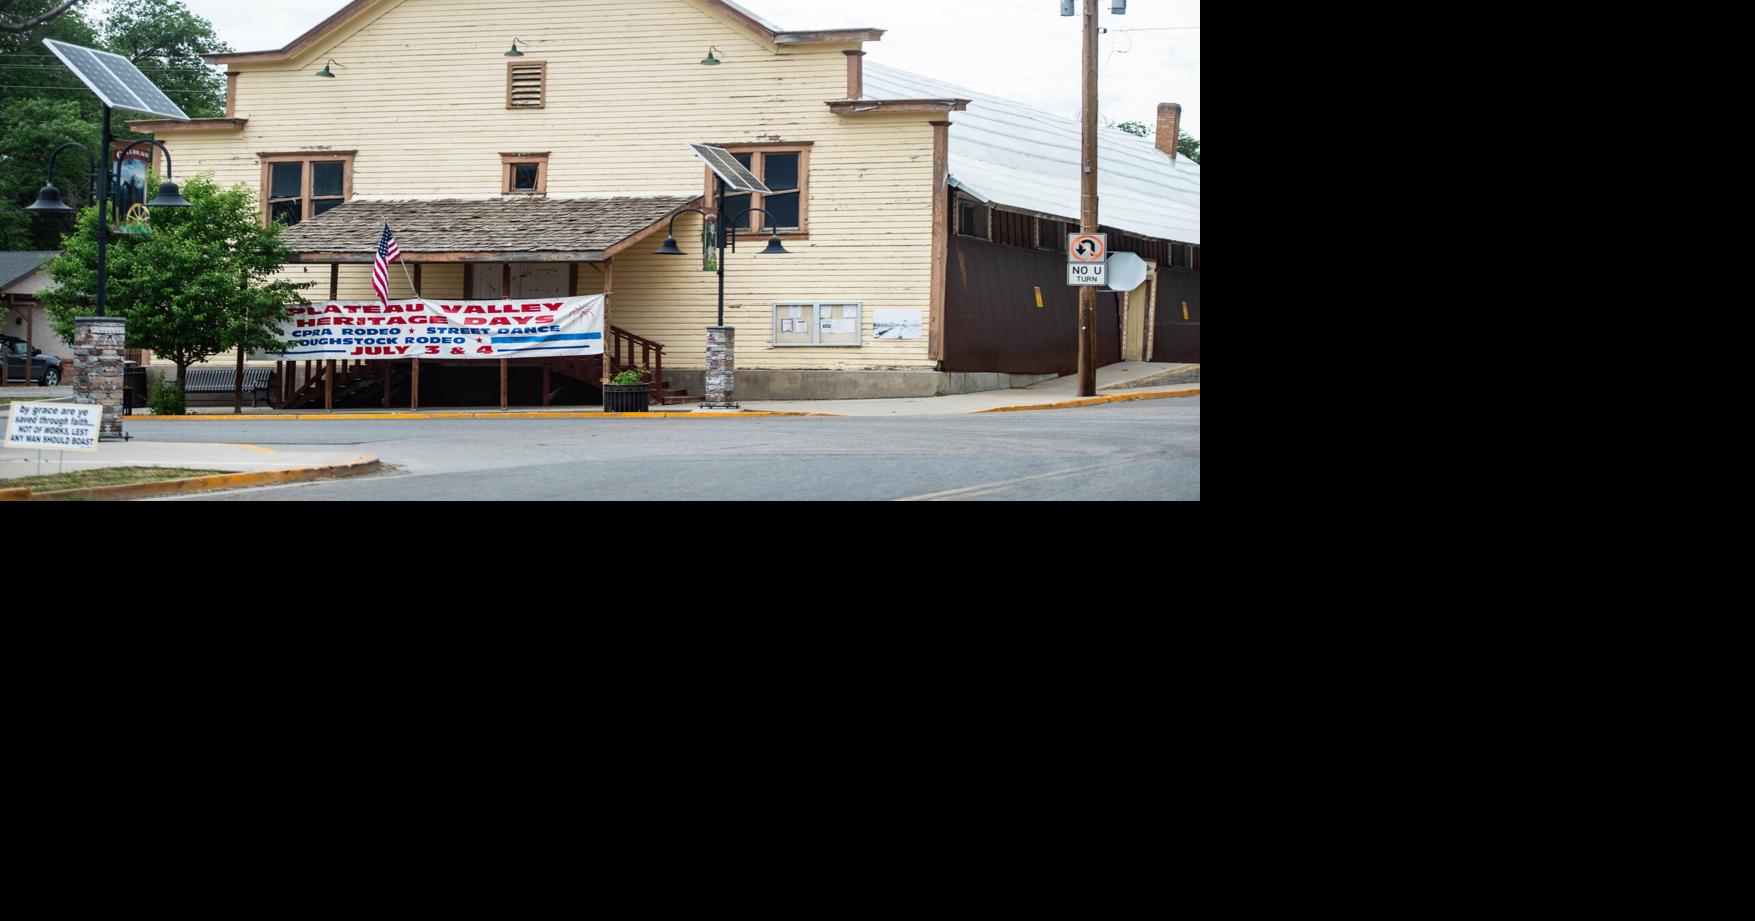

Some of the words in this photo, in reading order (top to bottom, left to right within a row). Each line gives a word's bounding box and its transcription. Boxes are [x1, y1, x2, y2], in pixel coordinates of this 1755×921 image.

[1072, 266, 1088, 275] NO
[1094, 266, 1101, 275] U
[286, 303, 424, 316] PLATEAU
[440, 302, 563, 313] VALLEY
[296, 315, 448, 328] HERITAGE
[464, 315, 554, 326] DAYS
[291, 328, 333, 337] CPRA
[341, 327, 402, 336] RODEO
[426, 326, 491, 335] STREET
[497, 325, 560, 334] DANCE
[405, 336, 466, 344] RODEO
[351, 345, 409, 356] JULY
[425, 345, 440, 355] 3
[450, 347, 465, 355] &
[476, 345, 494, 354] 4
[19, 404, 29, 415] by
[32, 407, 59, 415] grace
[78, 409, 89, 418] ye
[15, 416, 37, 424] saved
[39, 416, 69, 427] through
[10, 434, 24, 442] ANY
[26, 435, 40, 443] MAN
[42, 436, 70, 445] SHOULD
[71, 438, 94, 446] BOAST
